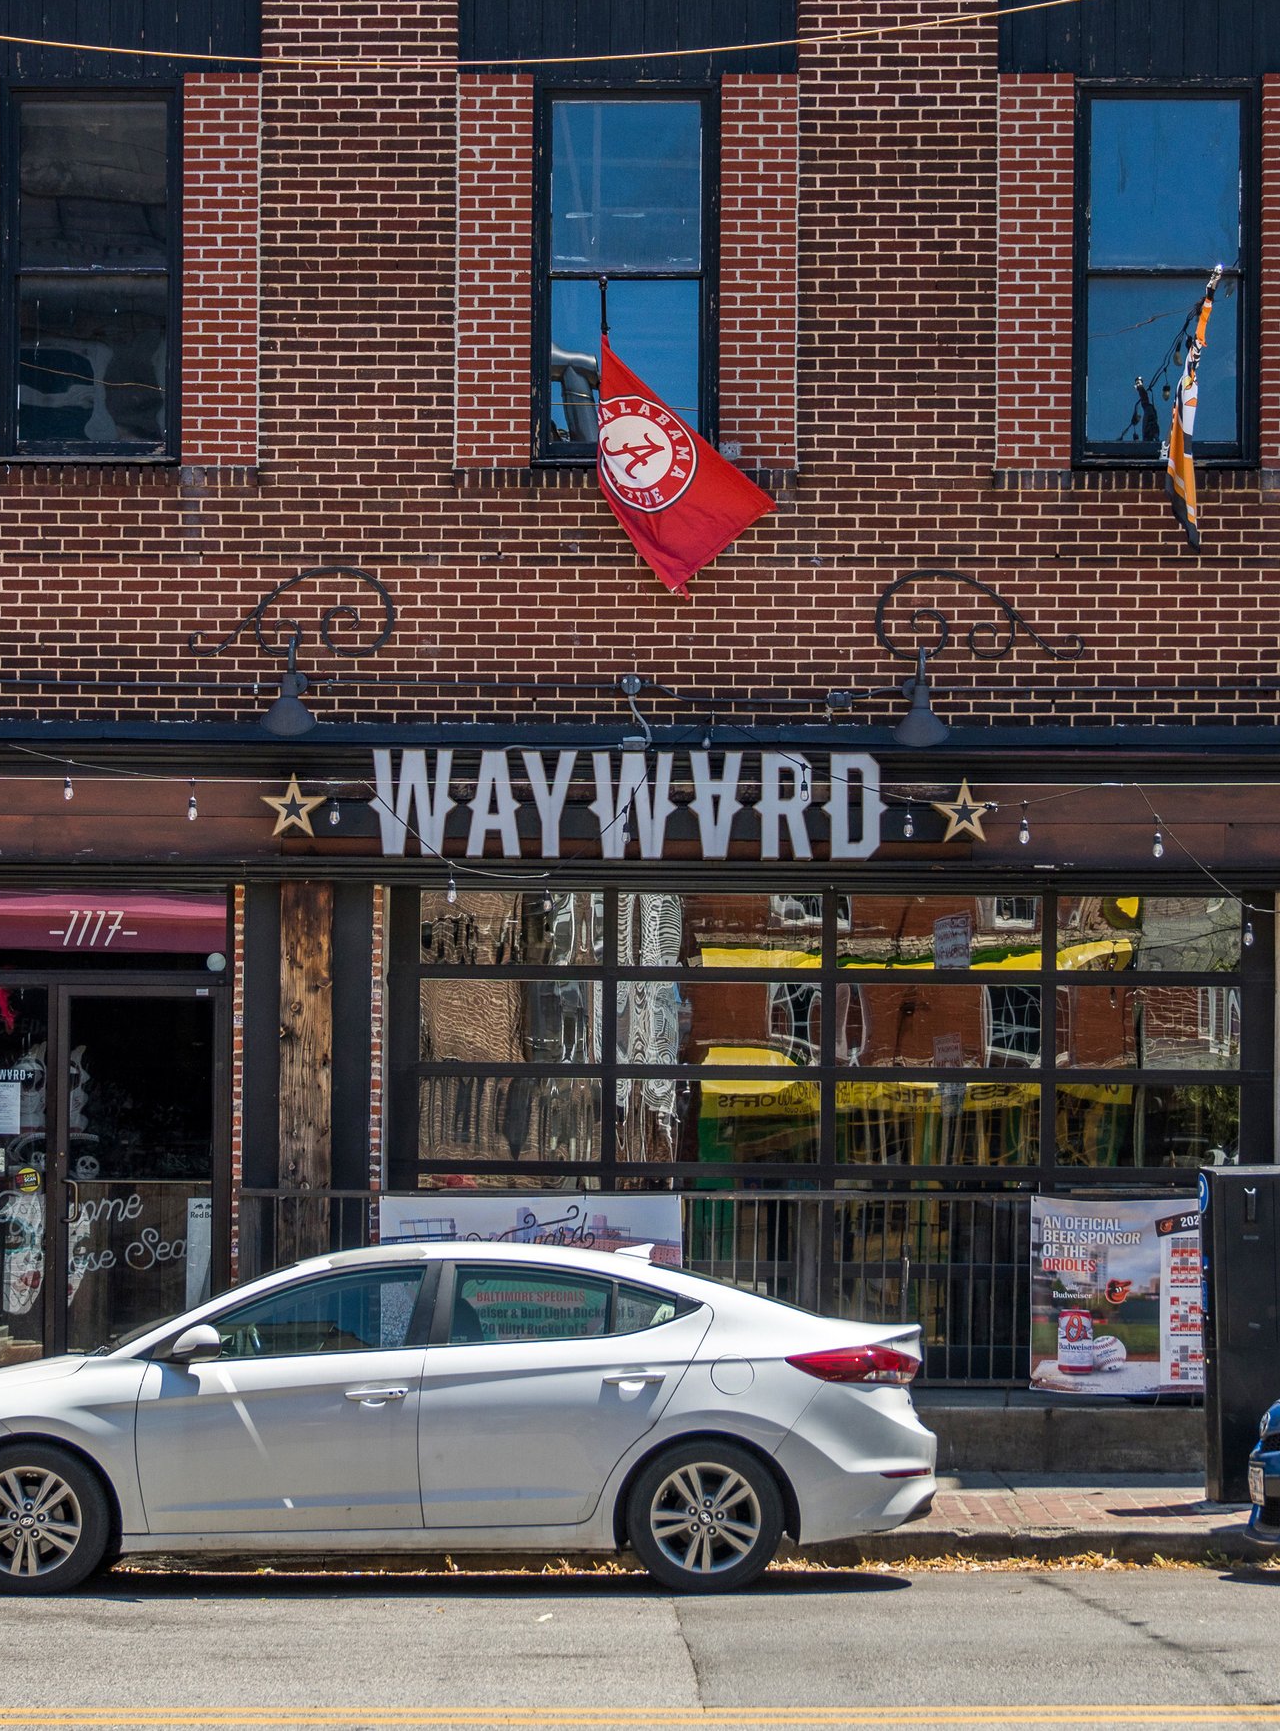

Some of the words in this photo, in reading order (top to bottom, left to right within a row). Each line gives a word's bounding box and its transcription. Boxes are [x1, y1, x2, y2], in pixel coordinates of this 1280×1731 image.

[1043, 1215, 1060, 1229] AN
[1065, 1216, 1121, 1231] OFFICIAL
[1043, 1229, 1076, 1244] BEER
[1079, 1231, 1141, 1245] SPONSOR
[1042, 1243, 1059, 1257] OF
[1062, 1244, 1087, 1258] THE
[1042, 1257, 1097, 1272] ORIOLES
[476, 1291, 534, 1302] BALTIMORE
[536, 1290, 586, 1302] SPECIALS
[1052, 1291, 1093, 1299] Budweiser
[520, 1307, 542, 1318] Bud
[545, 1306, 572, 1319] Light
[574, 1306, 607, 1318] Bucke
[527, 1323, 563, 1335] Bucket
[565, 1322, 578, 1334] of
[580, 1322, 588, 1333] 5
